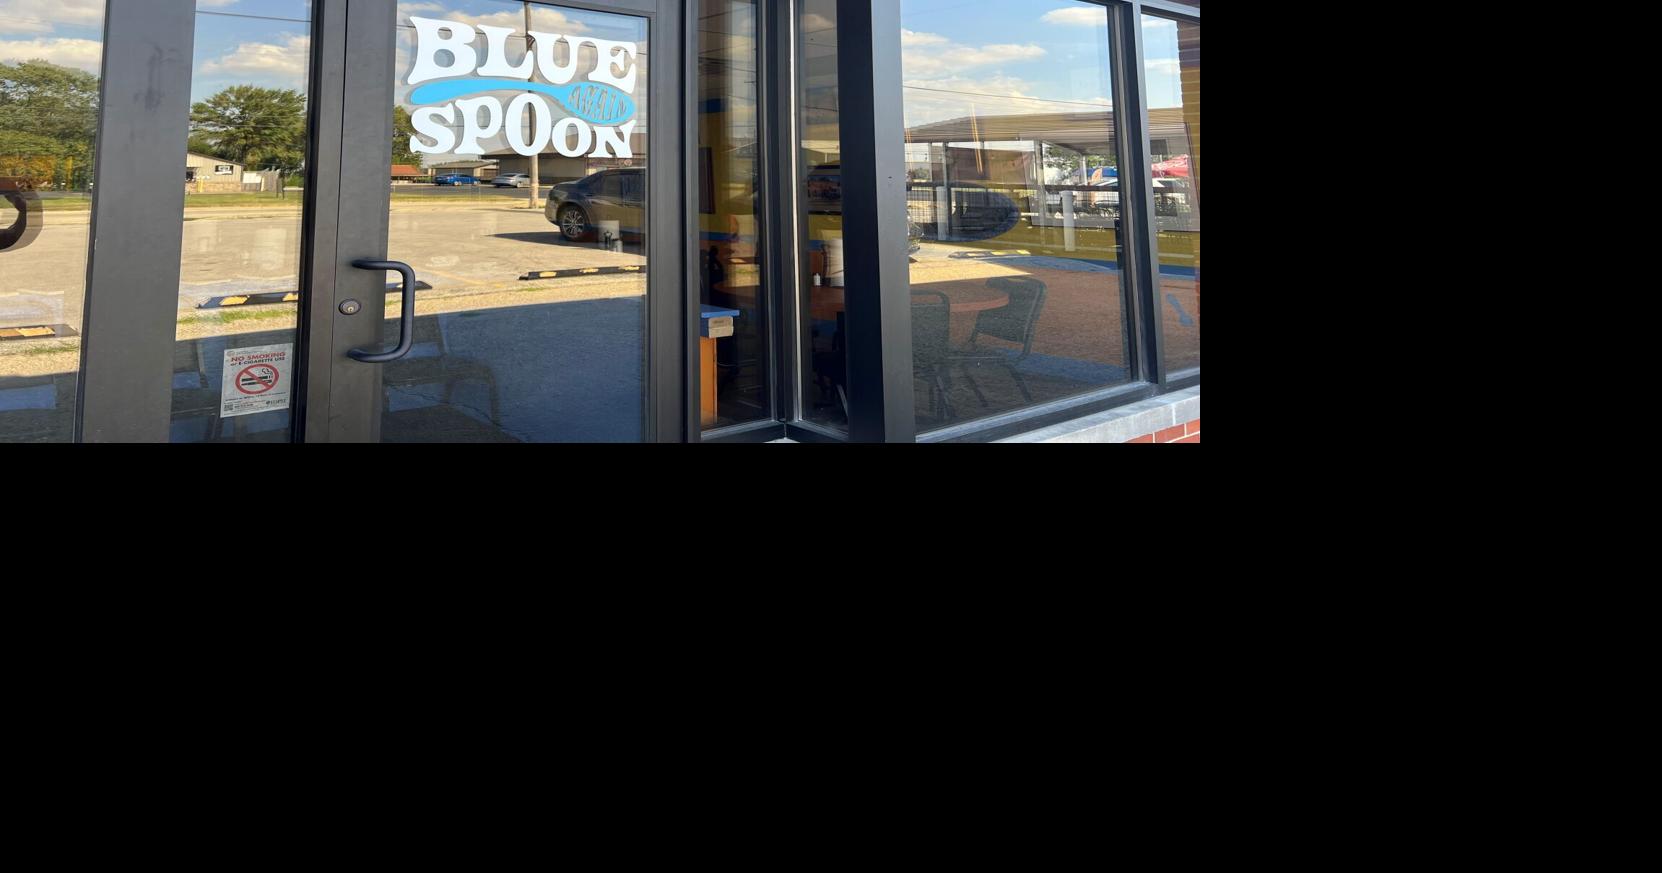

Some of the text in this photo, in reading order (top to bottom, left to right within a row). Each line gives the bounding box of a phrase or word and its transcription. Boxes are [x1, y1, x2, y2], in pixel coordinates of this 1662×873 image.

[407, 16, 637, 94] BLUE
[409, 93, 637, 158] SPOON
[247, 351, 286, 360] SMOKING
